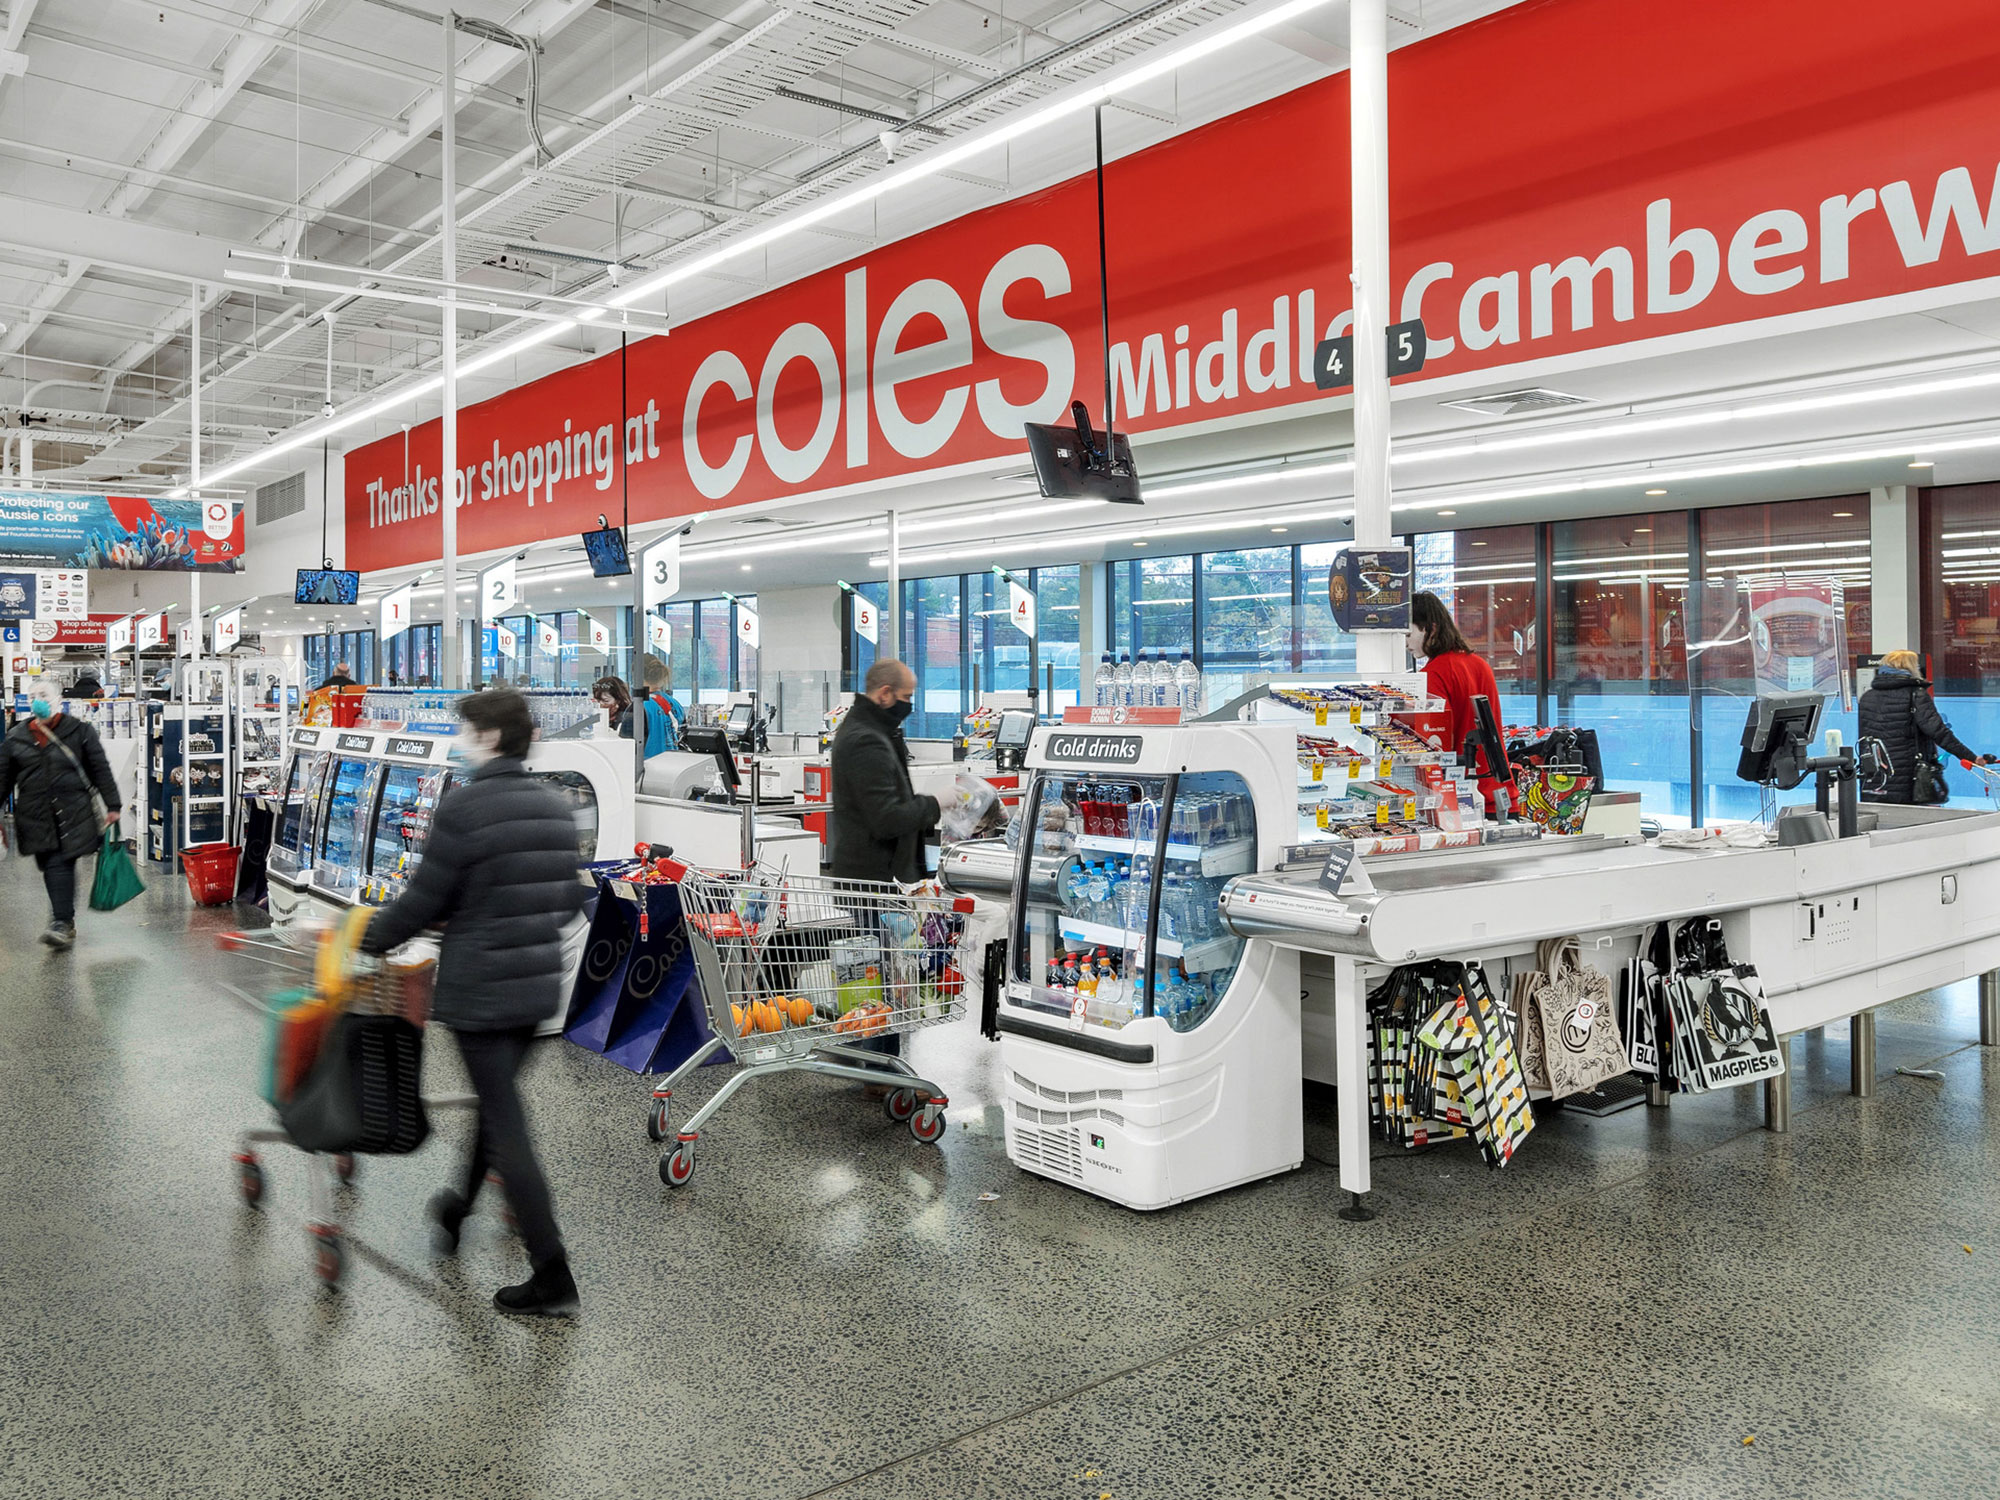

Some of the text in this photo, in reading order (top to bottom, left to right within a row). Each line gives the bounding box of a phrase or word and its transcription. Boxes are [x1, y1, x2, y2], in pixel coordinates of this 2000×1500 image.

[366, 464, 438, 528] Thanks
[480, 419, 614, 507] shopping
[625, 399, 660, 465] at
[682, 244, 1076, 499] coles
[1401, 161, 2000, 360] Camberw
[1398, 331, 1413, 361] 5
[1326, 348, 1343, 375] 4
[67, 501, 90, 510] our
[0, 509, 79, 522] Aussie icons
[654, 561, 668, 585] 3
[492, 581, 505, 600] 2
[393, 604, 398, 619] 1
[1018, 600, 1026, 615] 4
[861, 611, 869, 624] 5
[62, 620, 79, 632] Shop
[219, 622, 233, 634] 14
[744, 620, 751, 631] 6
[114, 630, 125, 641] 11
[143, 627, 157, 639] 12
[183, 629, 192, 640] 1
[545, 634, 552, 643] 9
[596, 632, 603, 642] 8
[657, 628, 663, 638] 7
[501, 635, 511, 645] 10
[345, 736, 369, 749] Cold Drinks
[396, 741, 426, 755] Cold Drinks
[1053, 738, 1136, 758] Cold drinks
[1708, 1055, 1769, 1082] MAGPIES
